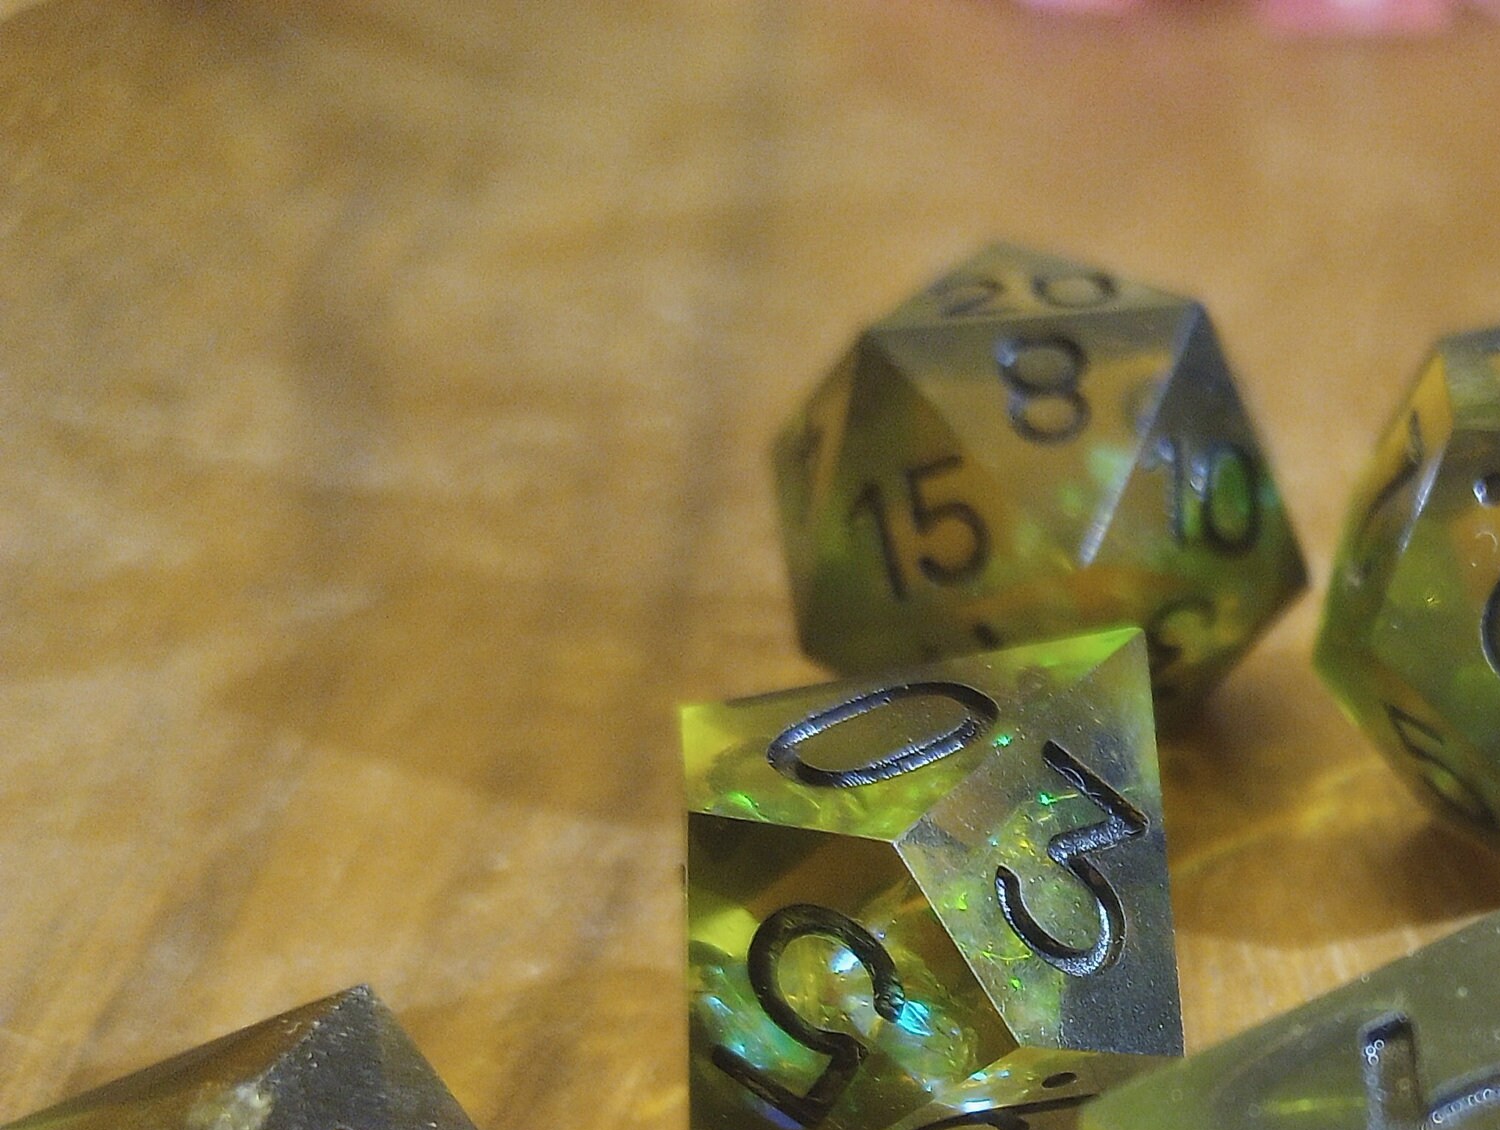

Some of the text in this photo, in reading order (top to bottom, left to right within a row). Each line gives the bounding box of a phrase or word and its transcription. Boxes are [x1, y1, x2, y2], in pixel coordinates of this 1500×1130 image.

[1000, 334, 1090, 444] 8
[849, 454, 989, 600] 15
[1144, 433, 1260, 557] 10
[767, 681, 1000, 787] 0
[994, 739, 1149, 978] 3
[711, 903, 905, 1130] 5
